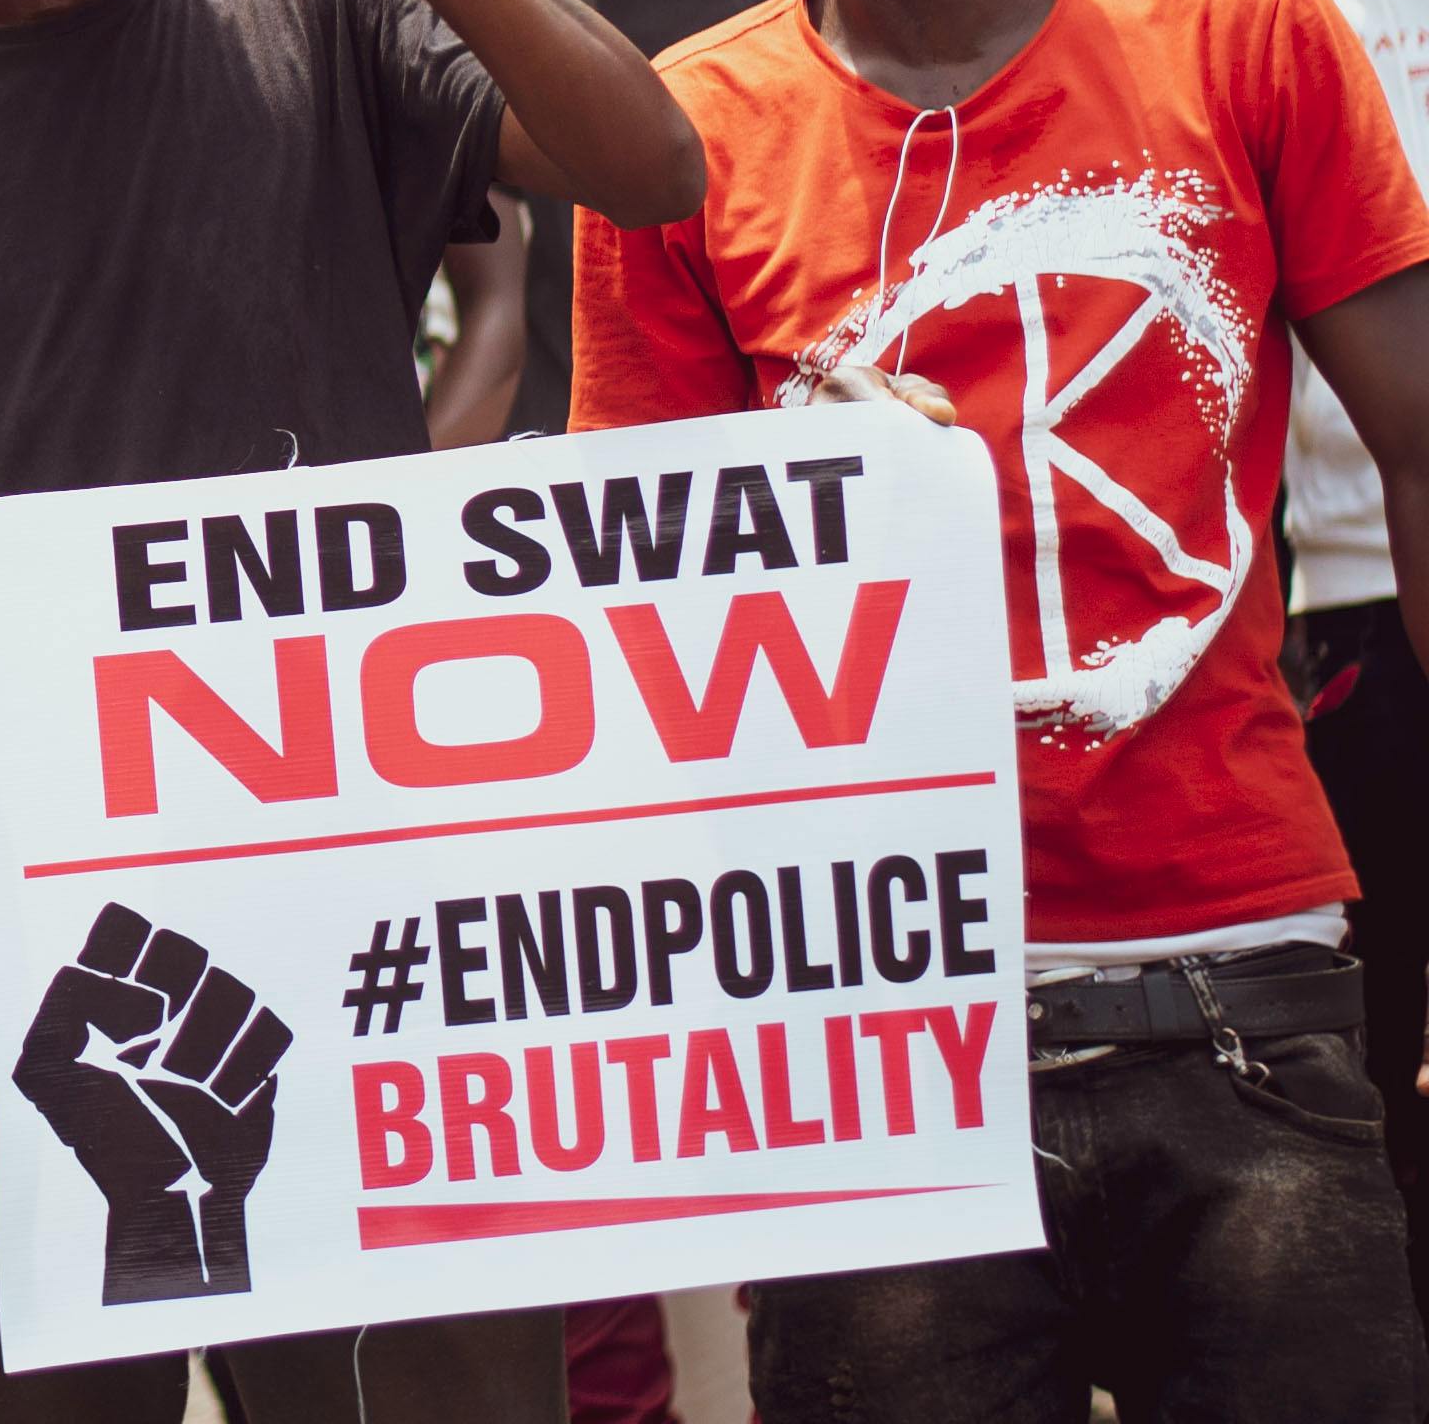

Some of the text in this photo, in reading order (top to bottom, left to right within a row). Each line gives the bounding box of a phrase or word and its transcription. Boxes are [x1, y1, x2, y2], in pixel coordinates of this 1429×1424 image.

[111, 456, 865, 632] END SWAT
[92, 579, 912, 819] NOW
[343, 848, 998, 1038] #ENDPOLICE
[351, 1001, 999, 1192] BRUTALITY
